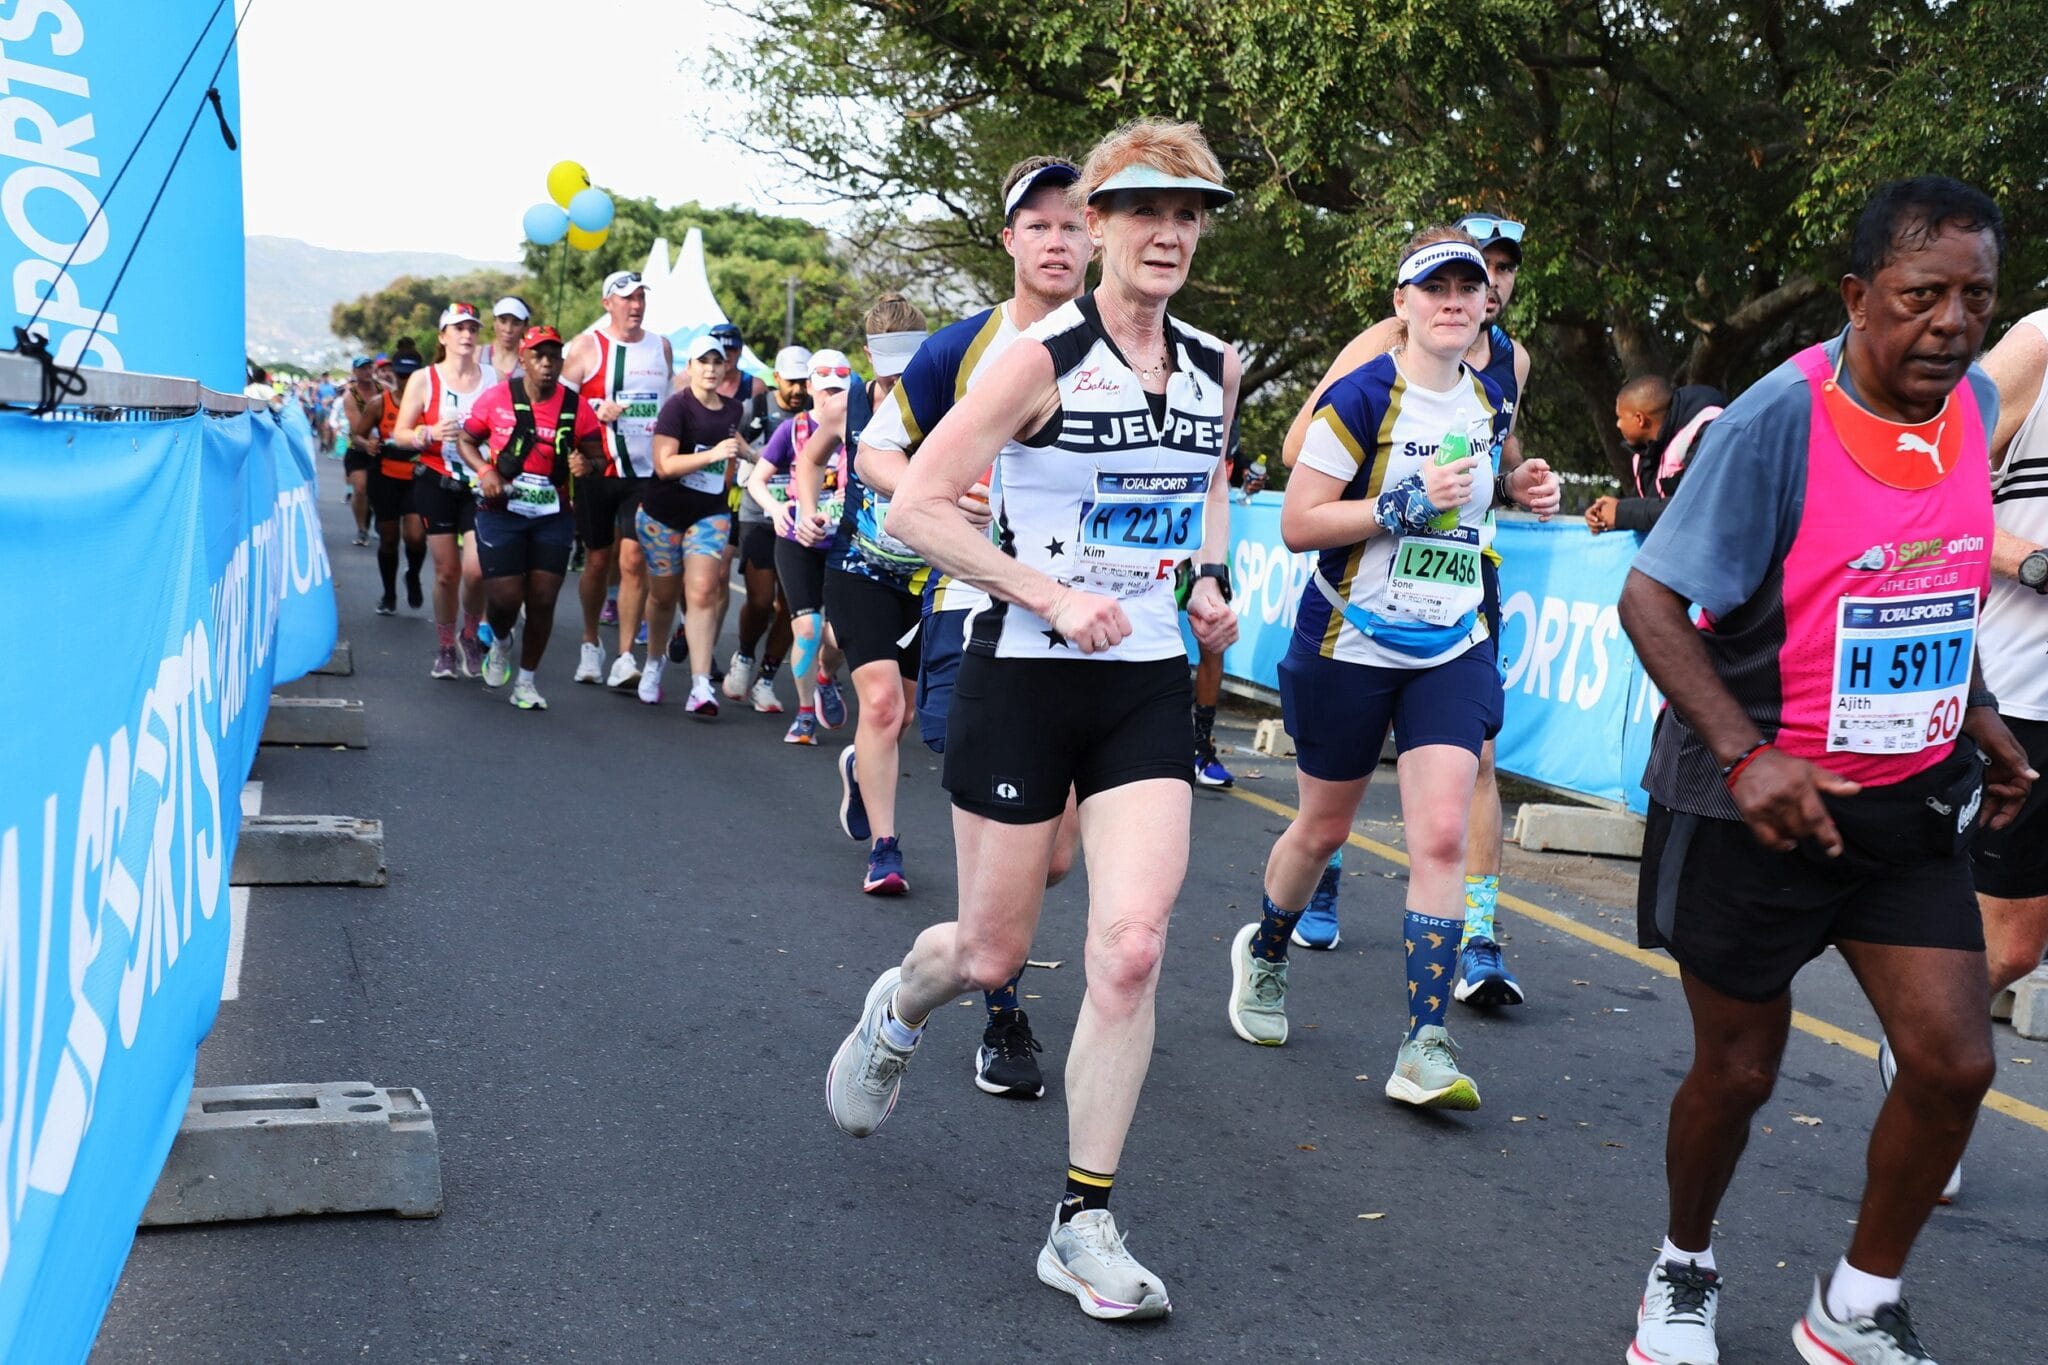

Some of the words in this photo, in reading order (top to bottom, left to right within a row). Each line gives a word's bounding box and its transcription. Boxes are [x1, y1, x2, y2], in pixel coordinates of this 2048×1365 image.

[1099, 412, 1214, 449] JEPPE
[1122, 477, 1188, 491] TOTALSPORTS
[1093, 508, 1115, 540] H
[1123, 507, 1192, 545] 2213
[1083, 545, 1105, 558] Kim
[1899, 539, 1942, 561] save
[1948, 536, 1984, 554] orion
[1404, 548, 1412, 574] L
[1416, 549, 1476, 584] 27456
[1392, 579, 1414, 589] Sone
[1880, 576, 1931, 591] ATHLETIC
[1933, 572, 1958, 586] CLUB
[1879, 604, 1953, 623] TOTALSPORTS
[1850, 647, 1872, 688] H
[1888, 637, 1963, 689] 5917
[1837, 697, 1871, 711] Ajith
[1926, 696, 1959, 742] 60
[1411, 914, 1451, 928] SSRC
